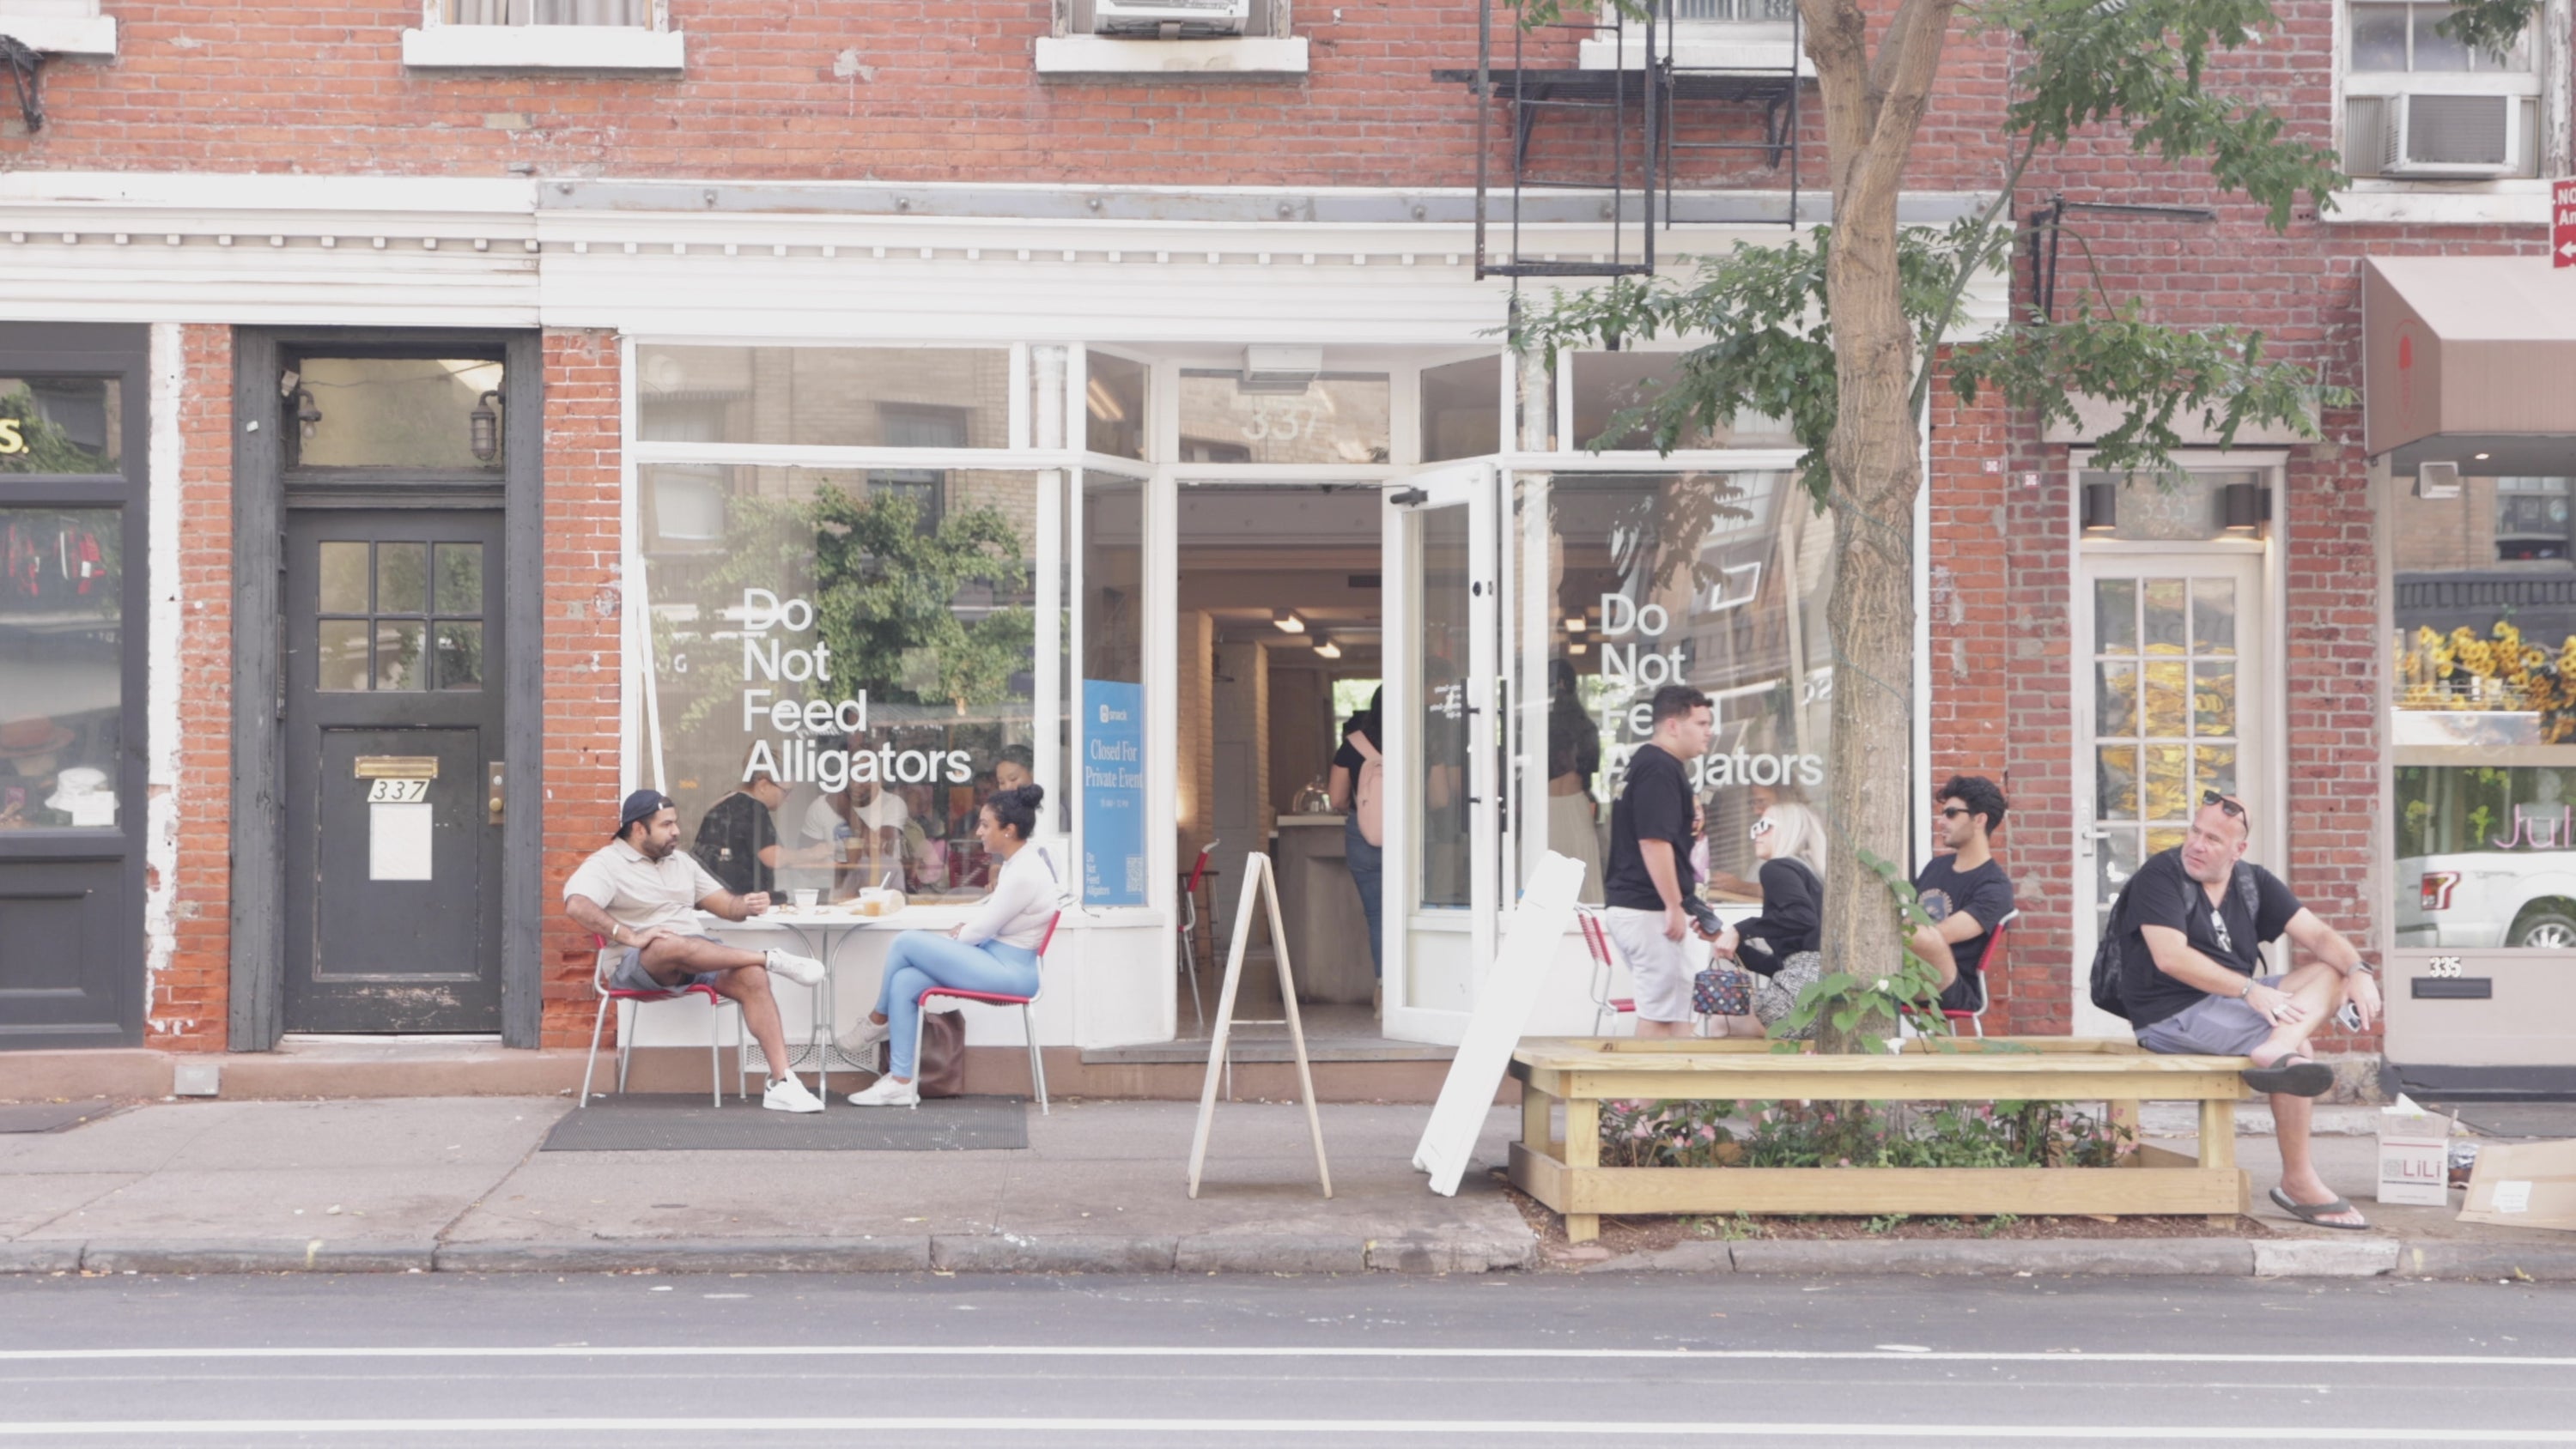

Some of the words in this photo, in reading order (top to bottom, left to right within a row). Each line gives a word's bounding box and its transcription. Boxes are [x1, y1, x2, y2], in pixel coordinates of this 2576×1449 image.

[743, 587, 813, 632] Do
[1601, 592, 1669, 637] Do
[743, 638, 831, 682] Not
[1601, 643, 1686, 688] Not
[743, 688, 868, 732] Feed
[1601, 694, 1722, 737] Fe
[741, 739, 973, 793] Alligators
[1090, 737, 1121, 761] Closed
[1122, 740, 1138, 762] For
[1601, 743, 1824, 794] Agators
[373, 780, 427, 801] 337
[1085, 765, 1117, 788] Private
[1119, 767, 1143, 790] Event
[2429, 955, 2463, 979] 335
